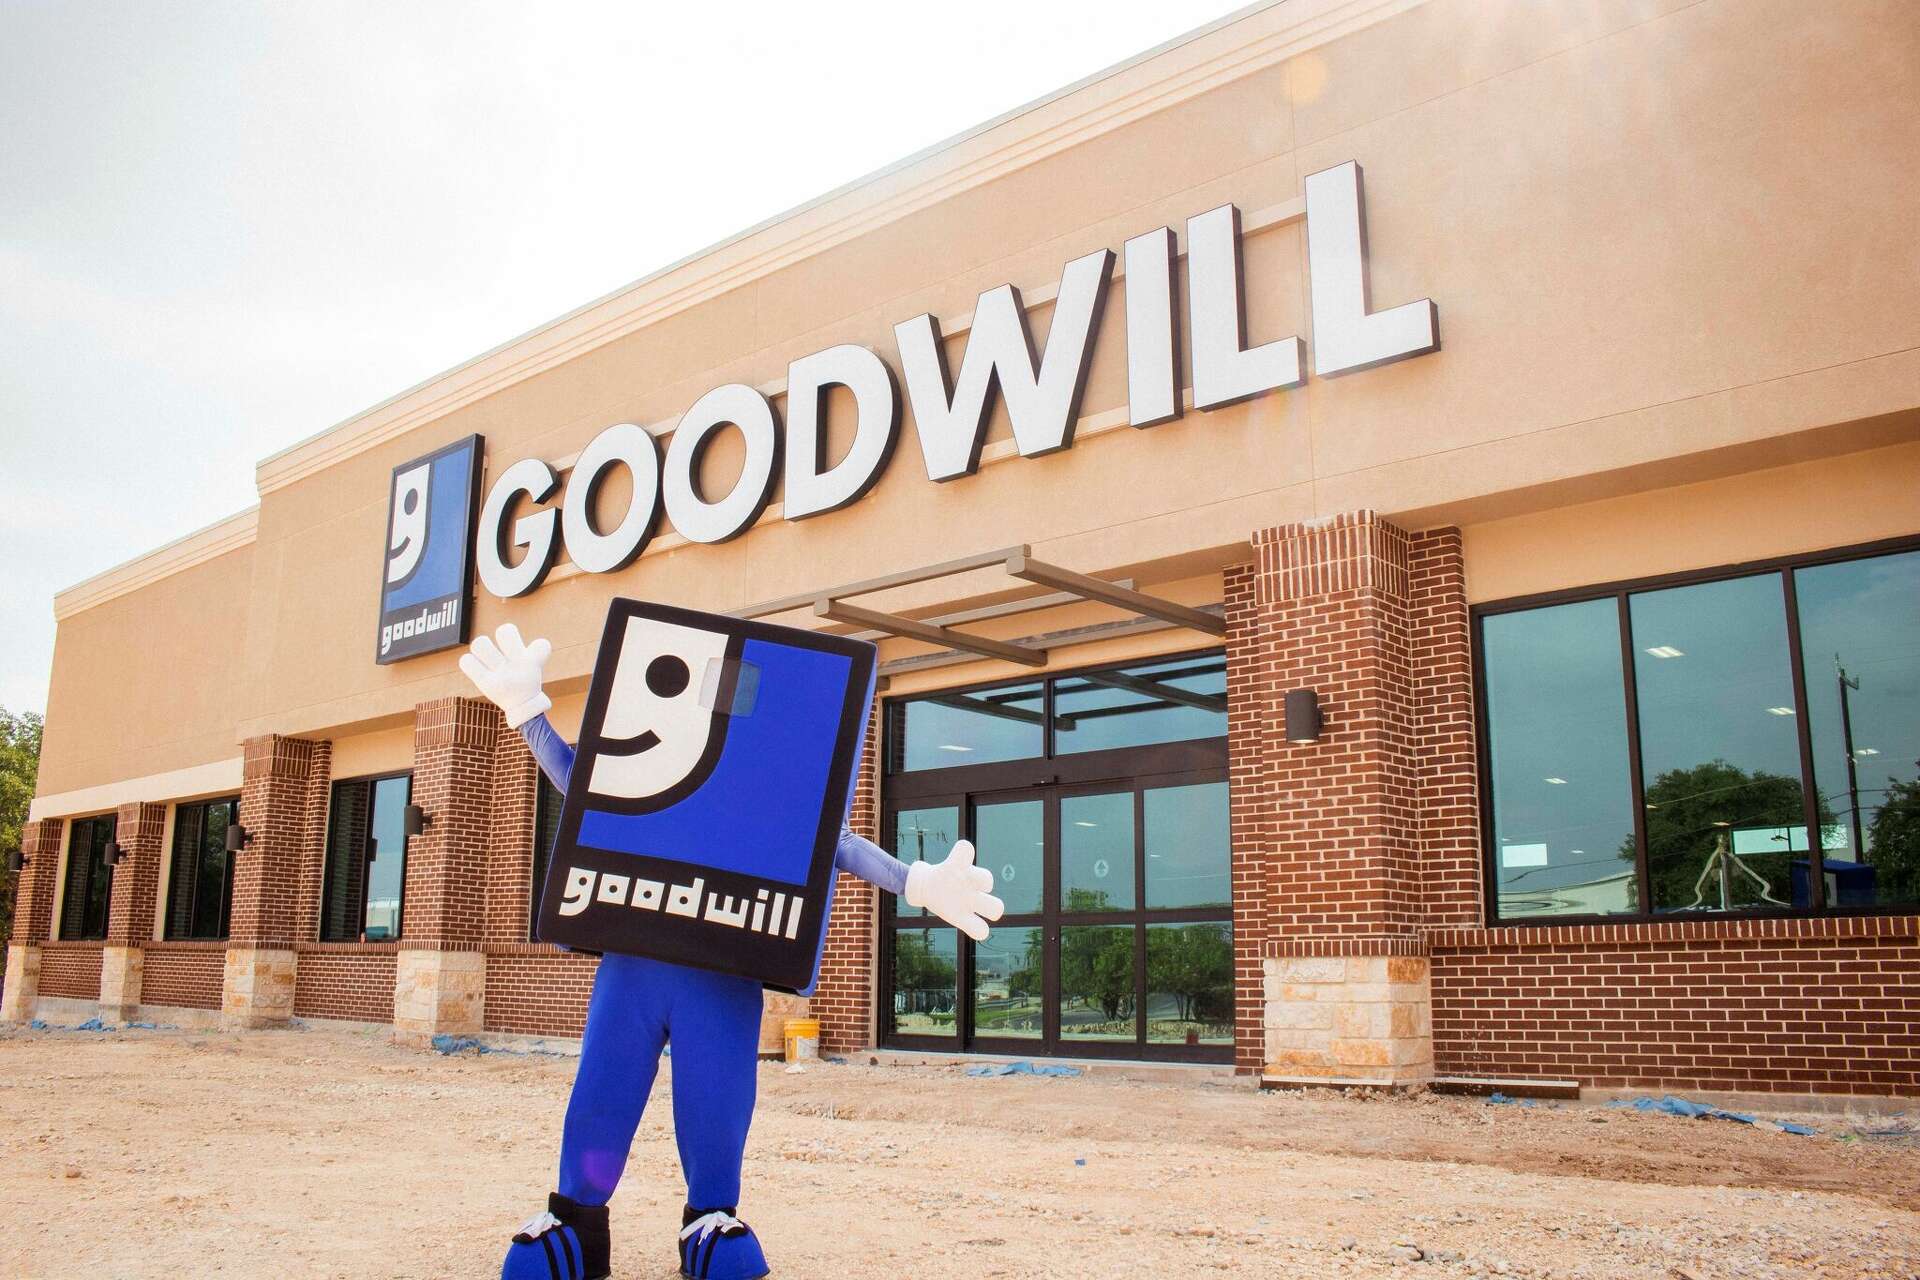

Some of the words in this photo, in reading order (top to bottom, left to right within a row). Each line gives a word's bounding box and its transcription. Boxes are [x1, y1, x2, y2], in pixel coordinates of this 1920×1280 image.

[476, 159, 1441, 598] GOODWILL
[381, 598, 458, 656] goodwill
[558, 866, 804, 940] goodwill
